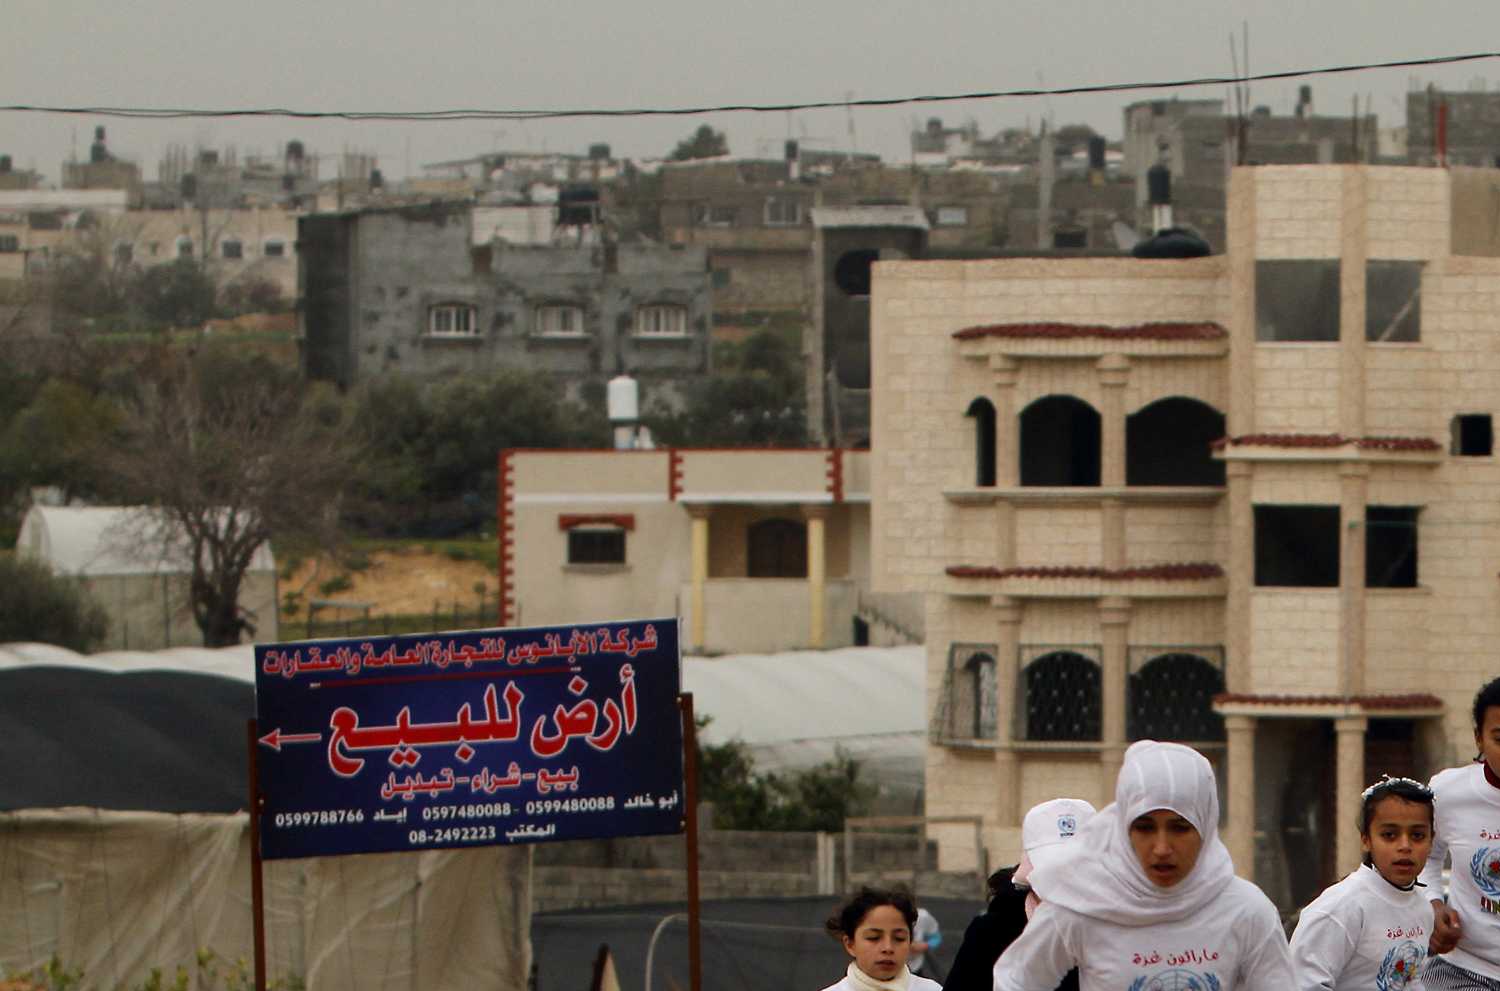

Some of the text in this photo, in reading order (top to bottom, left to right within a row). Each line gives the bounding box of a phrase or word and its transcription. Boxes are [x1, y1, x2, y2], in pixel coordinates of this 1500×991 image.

[598, 624, 658, 657] شركة
[263, 646, 361, 679] والعقارات
[361, 642, 431, 667] العامة
[431, 636, 505, 668] للتجارة
[328, 664, 638, 777] أرض للبيع
[422, 802, 511, 821] 0597480088
[526, 797, 615, 815] 0599480088
[624, 793, 655, 808] خالد
[275, 809, 365, 827] 0599788766
[409, 824, 556, 843] المكتب 08-2492223
